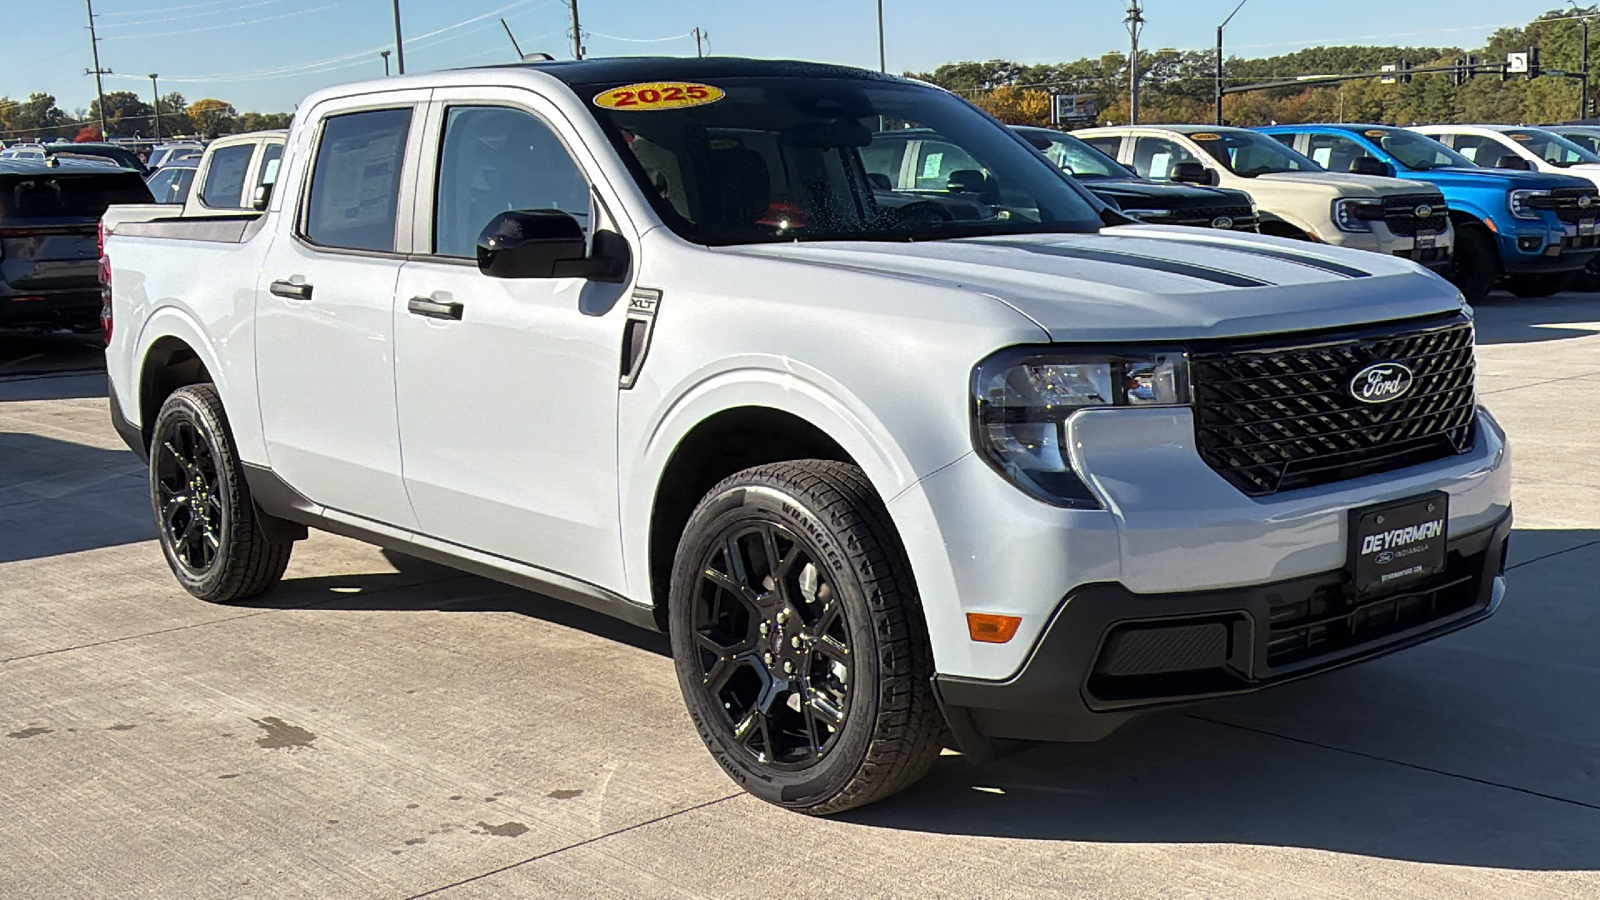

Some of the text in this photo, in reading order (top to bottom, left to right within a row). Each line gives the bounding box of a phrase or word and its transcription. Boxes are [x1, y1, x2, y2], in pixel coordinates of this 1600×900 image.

[613, 86, 709, 107] 2025
[629, 298, 655, 308] XLT
[1362, 367, 1403, 398] Ford
[782, 502, 842, 571] WRANGLER
[1361, 519, 1444, 555] DEYARMAN
